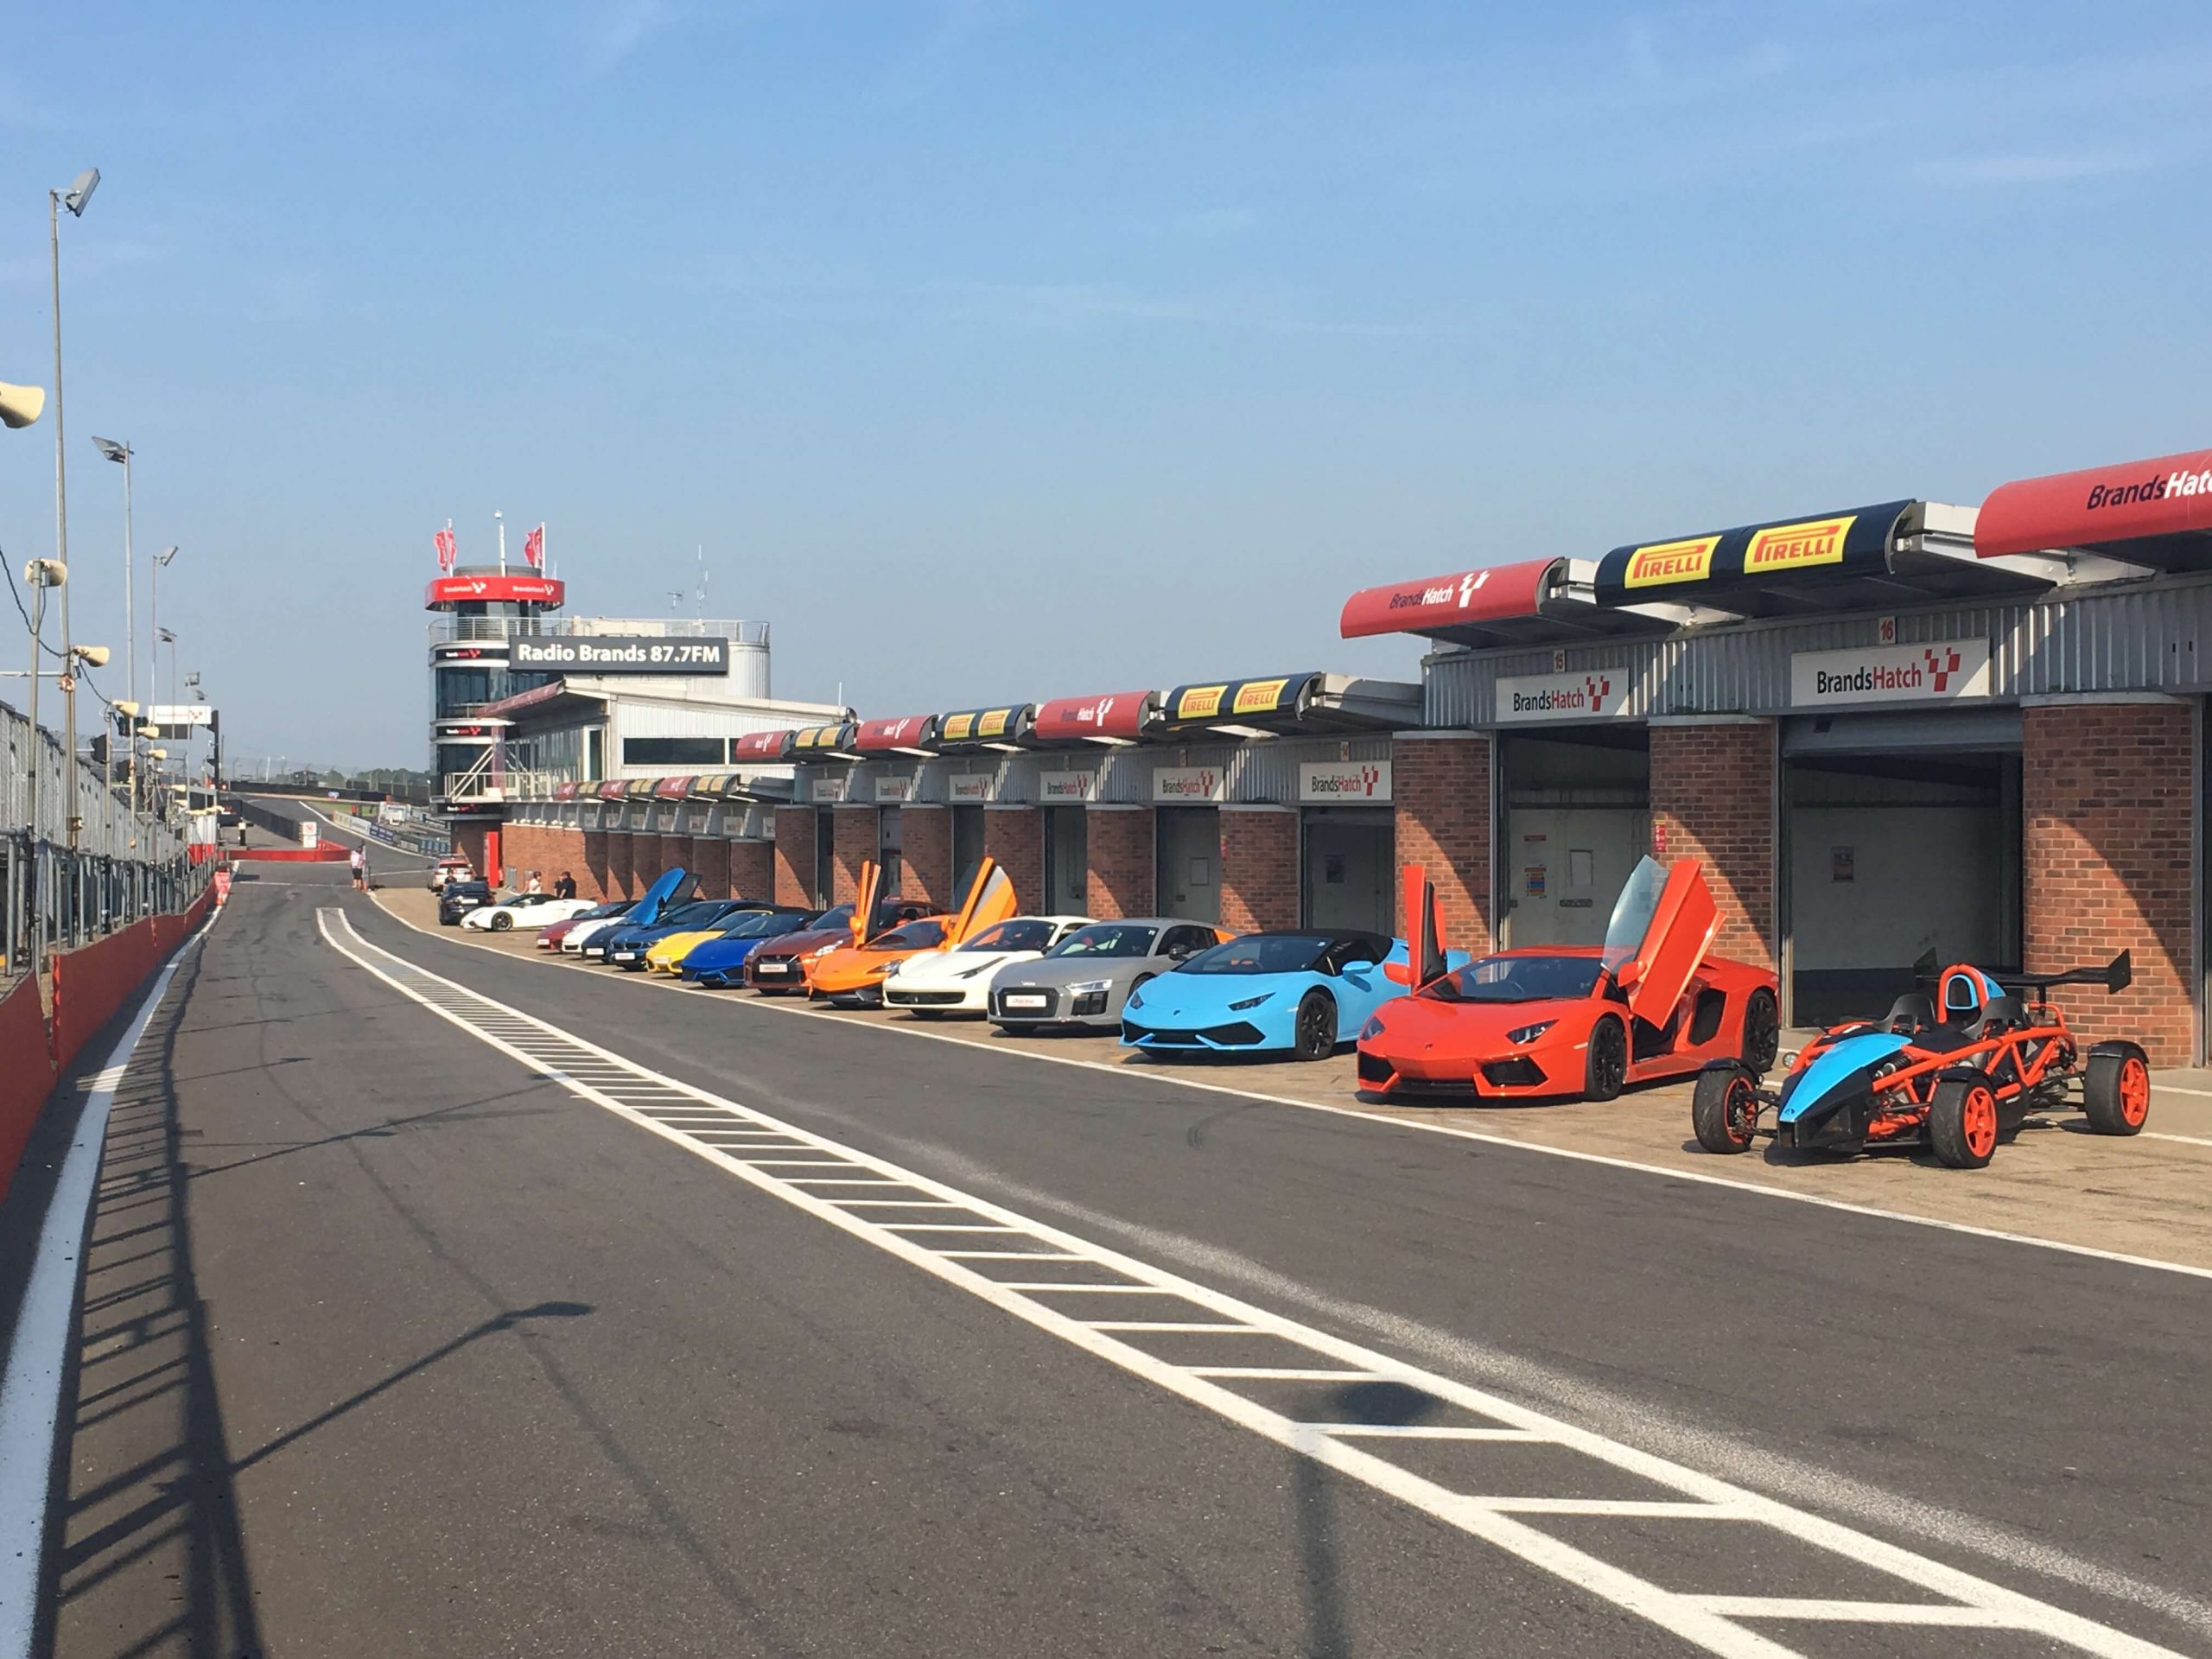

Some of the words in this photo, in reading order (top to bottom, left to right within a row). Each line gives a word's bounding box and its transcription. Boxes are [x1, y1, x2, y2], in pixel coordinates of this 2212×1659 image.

[1752, 524, 1841, 563] PIRELLI
[1632, 544, 1708, 579] PIRELLI
[1389, 584, 1454, 609] BrandsHatch
[1880, 620, 1894, 641] 16
[518, 644, 575, 662] Radio
[579, 645, 646, 663] Brands
[650, 645, 720, 663] 87.7FM
[1817, 662, 1922, 694] BrandsHatch
[1182, 691, 1219, 713] PIRELLI
[1237, 684, 1281, 707] PIRELLI
[1513, 688, 1585, 712] BrandsHatch
[1162, 778, 1200, 794] BrandsHatch
[1312, 775, 1361, 793] BrandsHatch
